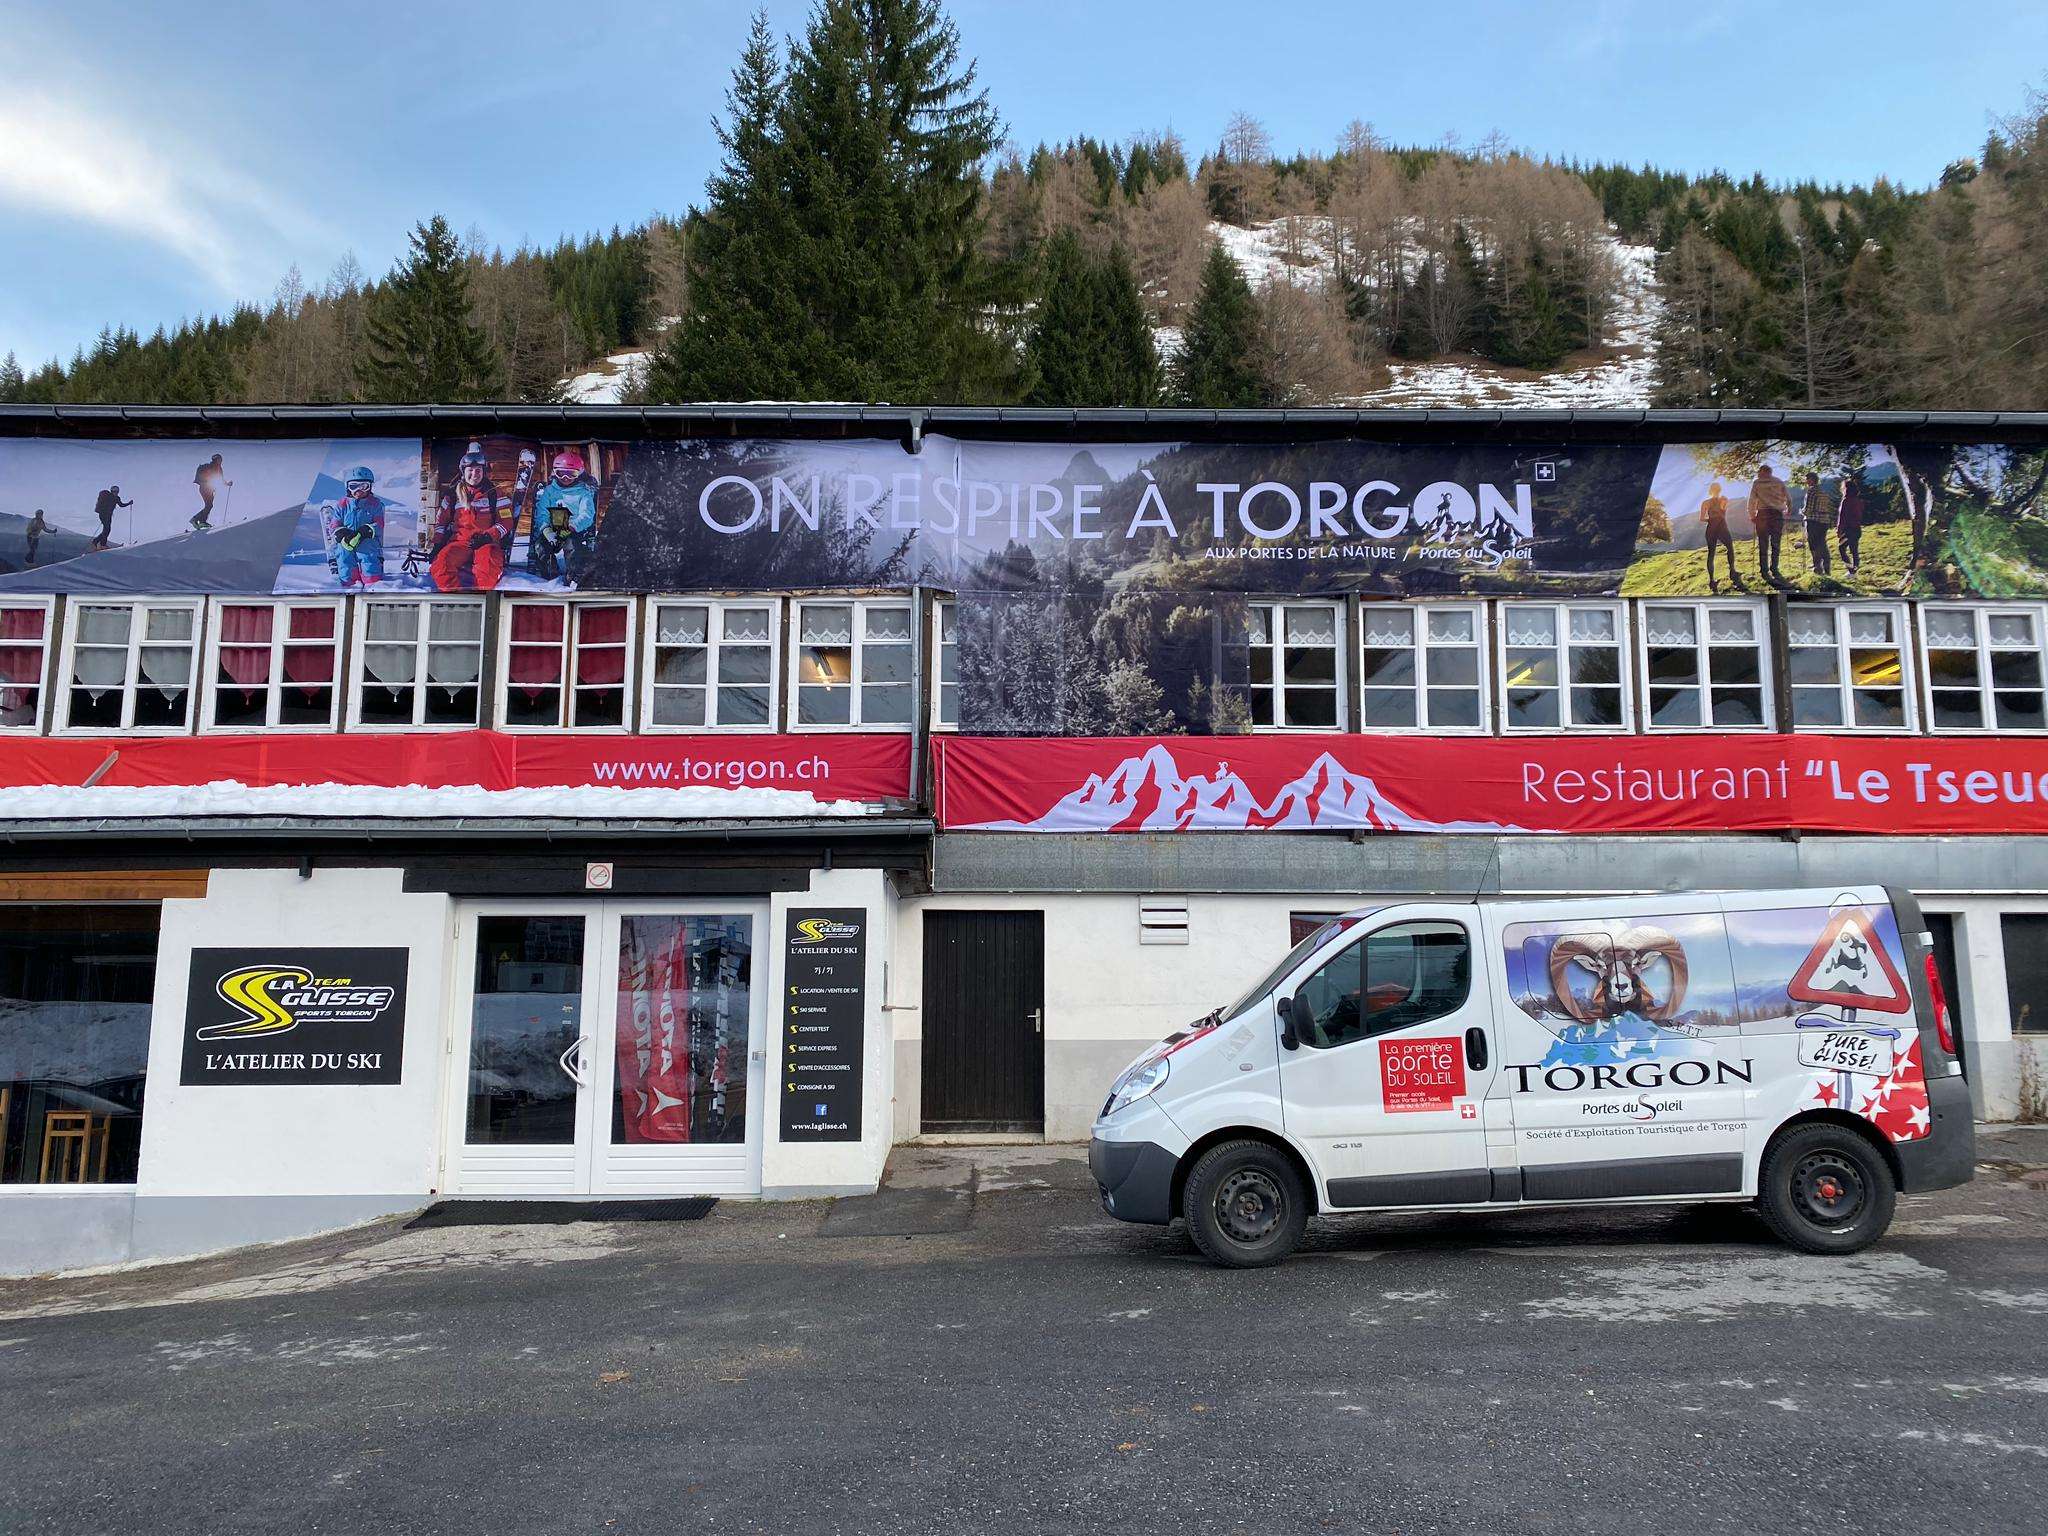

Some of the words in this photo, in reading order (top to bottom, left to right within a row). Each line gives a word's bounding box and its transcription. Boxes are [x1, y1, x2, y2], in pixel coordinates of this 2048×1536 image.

[699, 475, 820, 534] ON
[847, 473, 1104, 540] RESPIRE
[1125, 469, 1179, 539] À
[1196, 480, 1534, 547] TORGON
[1204, 546, 1236, 559] AUX
[1240, 547, 1294, 560] PORTES
[1298, 547, 1316, 560] DE
[1320, 546, 1339, 559] LA
[1343, 545, 1397, 560] NATURE
[1419, 546, 1462, 560] Portes
[1465, 546, 1483, 559] du
[1473, 539, 1534, 568] Soleil
[592, 755, 829, 785] www.torgon.ch
[1523, 760, 1791, 803] Restaurant
[268, 980, 294, 990] LA
[314, 978, 352, 986] TEAM
[280, 991, 389, 1006] GLISSE
[1384, 1044, 1399, 1055] La
[1403, 1042, 1453, 1056] première
[1823, 1032, 1871, 1051] PURE
[205, 1053, 305, 1071] L'ATELIER
[311, 1053, 343, 1070] DU
[347, 1053, 382, 1070] SKI
[1387, 1051, 1453, 1075] porte
[1813, 1047, 1878, 1070] GLISSE!
[1387, 1073, 1407, 1087] DU
[1413, 1071, 1457, 1086] SOLEIL
[1503, 1058, 1756, 1094] TORGON
[1582, 1102, 1620, 1116] Portes
[1623, 1101, 1639, 1114] du
[1632, 1093, 1683, 1120] Soleil
[791, 1122, 848, 1132] www.laglisse.ch
[1525, 1129, 1563, 1140] Société
[1564, 1125, 1635, 1140] d'Exploitation
[1635, 1123, 1695, 1137] Touristique
[1696, 1122, 1710, 1132] de
[1711, 1120, 1748, 1133] Torgon
